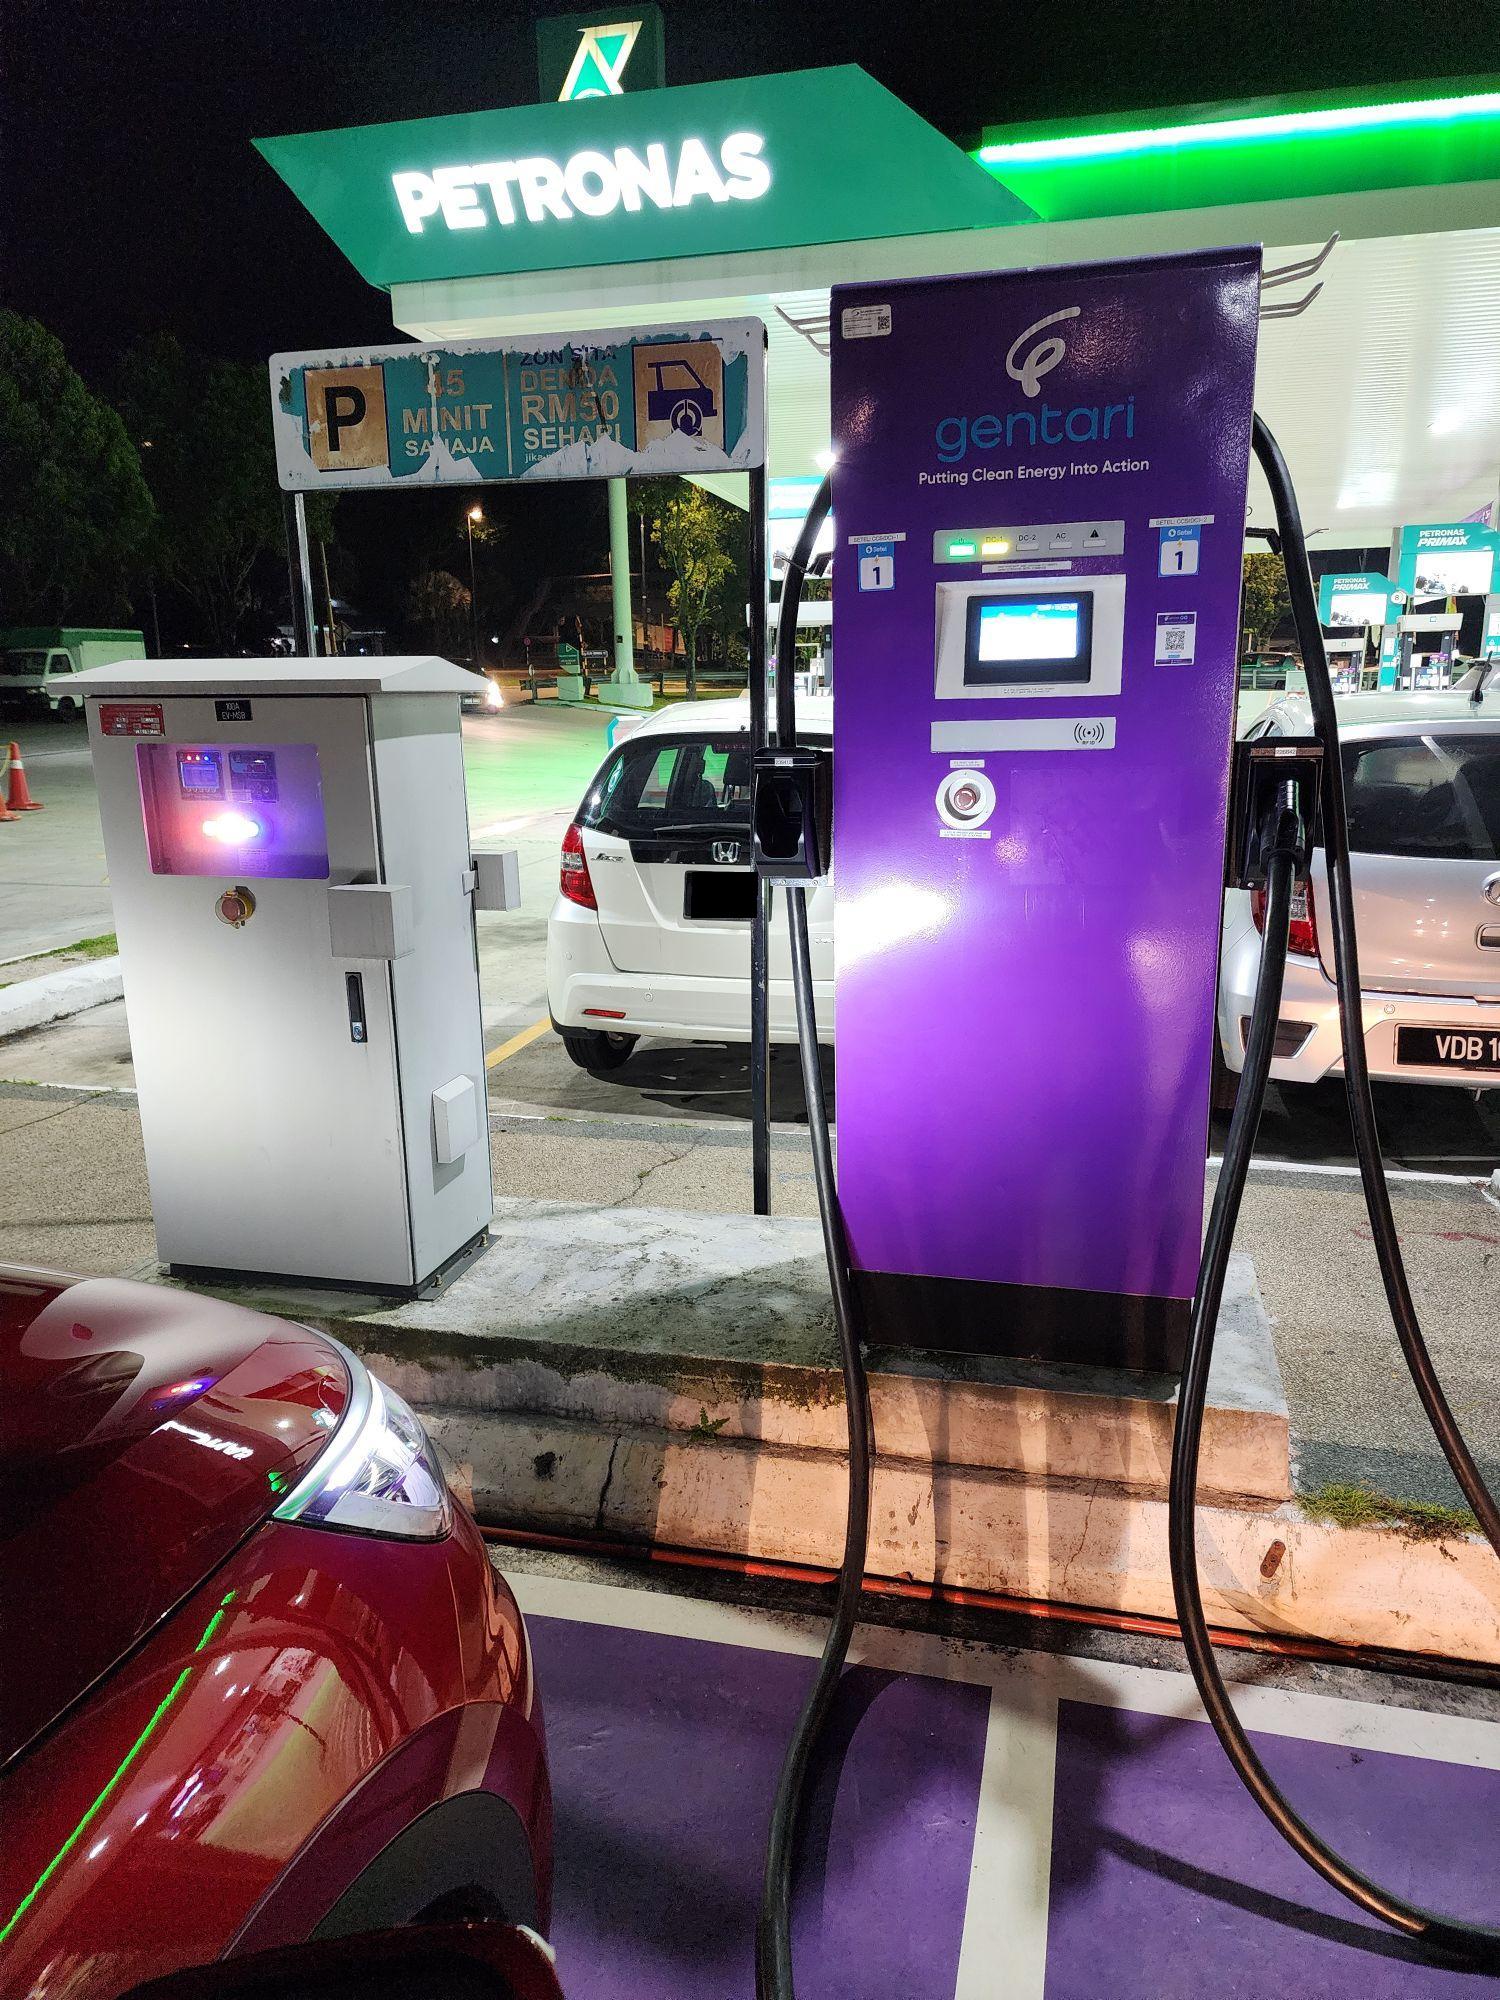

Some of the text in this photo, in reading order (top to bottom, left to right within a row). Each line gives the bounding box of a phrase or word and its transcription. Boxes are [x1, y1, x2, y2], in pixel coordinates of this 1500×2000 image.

[392, 132, 771, 234] PETRONAS
[520, 350, 564, 366] ZON
[324, 386, 367, 452] P
[402, 404, 493, 433] MINIT
[521, 390, 620, 425] RM50
[935, 395, 1135, 463] gentari
[918, 458, 1150, 486] Putting Clean Energy Into Action
[1018, 534, 1037, 542] DC-2
[1417, 535, 1471, 547] PRIMAX
[1419, 528, 1465, 538] PETRONAS
[1174, 551, 1183, 570] 1
[872, 566, 880, 585] 1
[1331, 582, 1370, 591] PRIMAX
[1435, 1034, 1500, 1062] VDB 1
